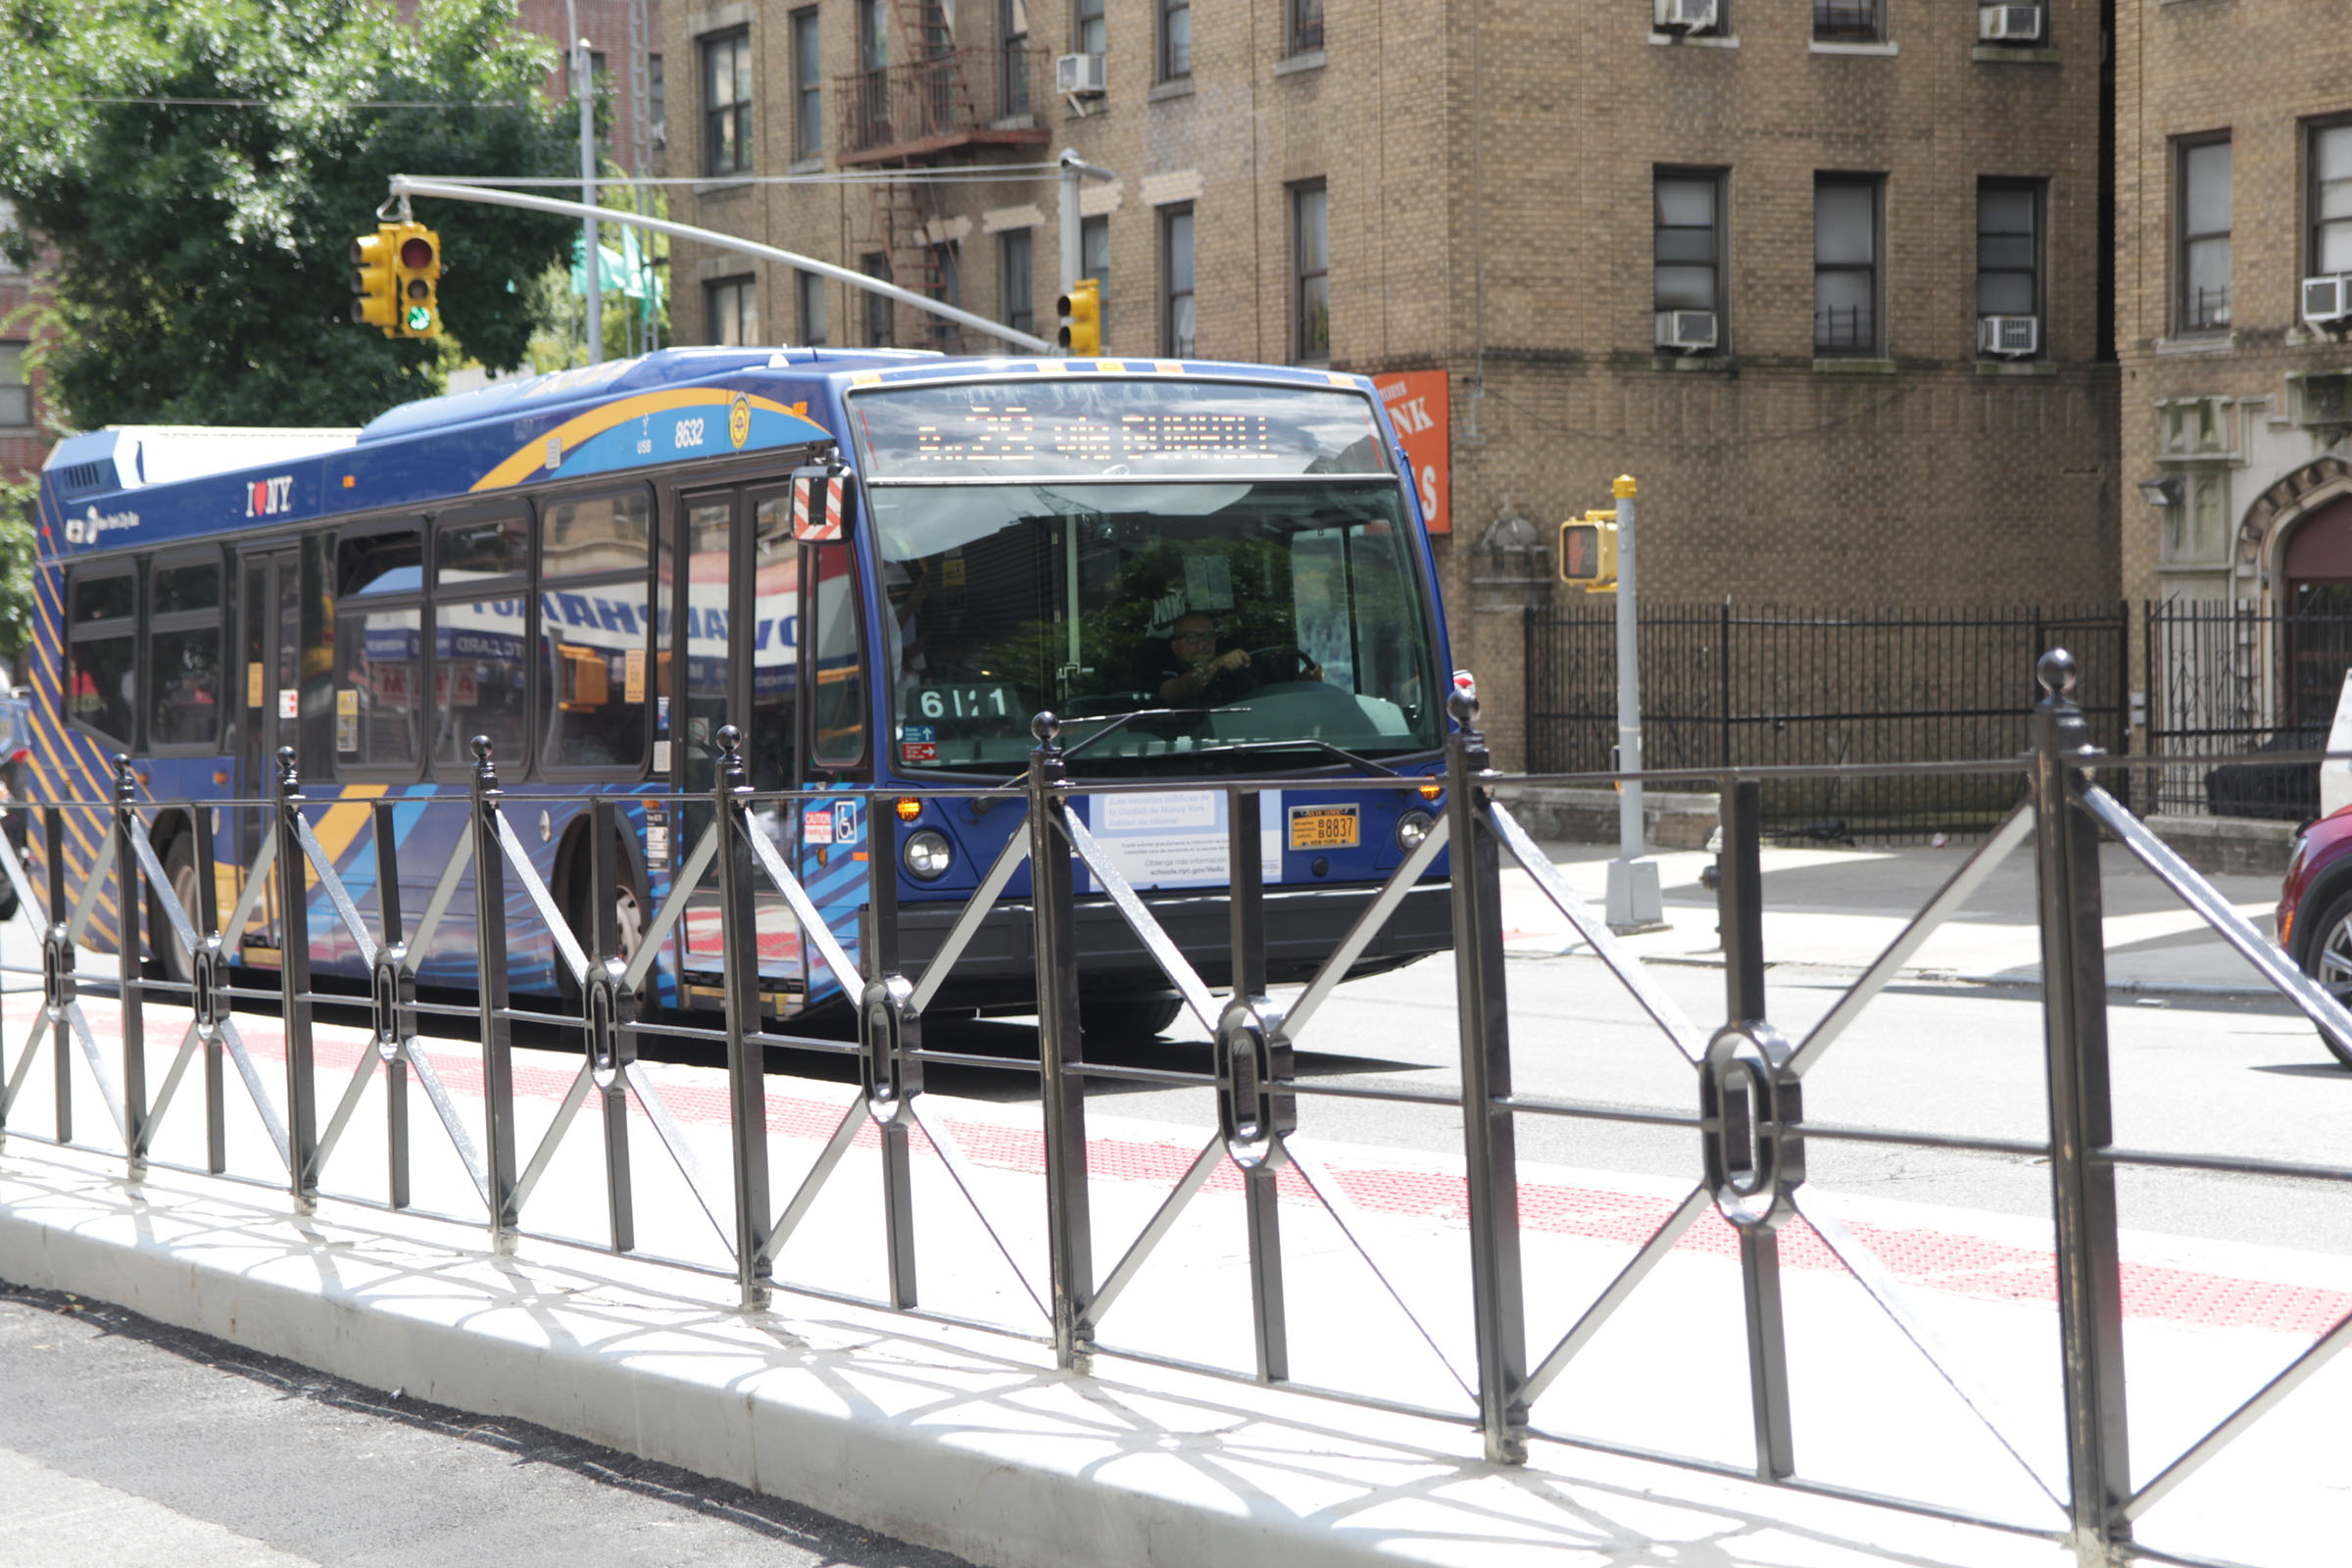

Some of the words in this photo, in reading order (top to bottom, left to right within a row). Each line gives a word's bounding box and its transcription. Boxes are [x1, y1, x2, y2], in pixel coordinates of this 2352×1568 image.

[674, 417, 705, 449] 8632
[636, 438, 652, 455] USB
[806, 813, 831, 825] CAUTION
[1326, 816, 1353, 838] 8837
